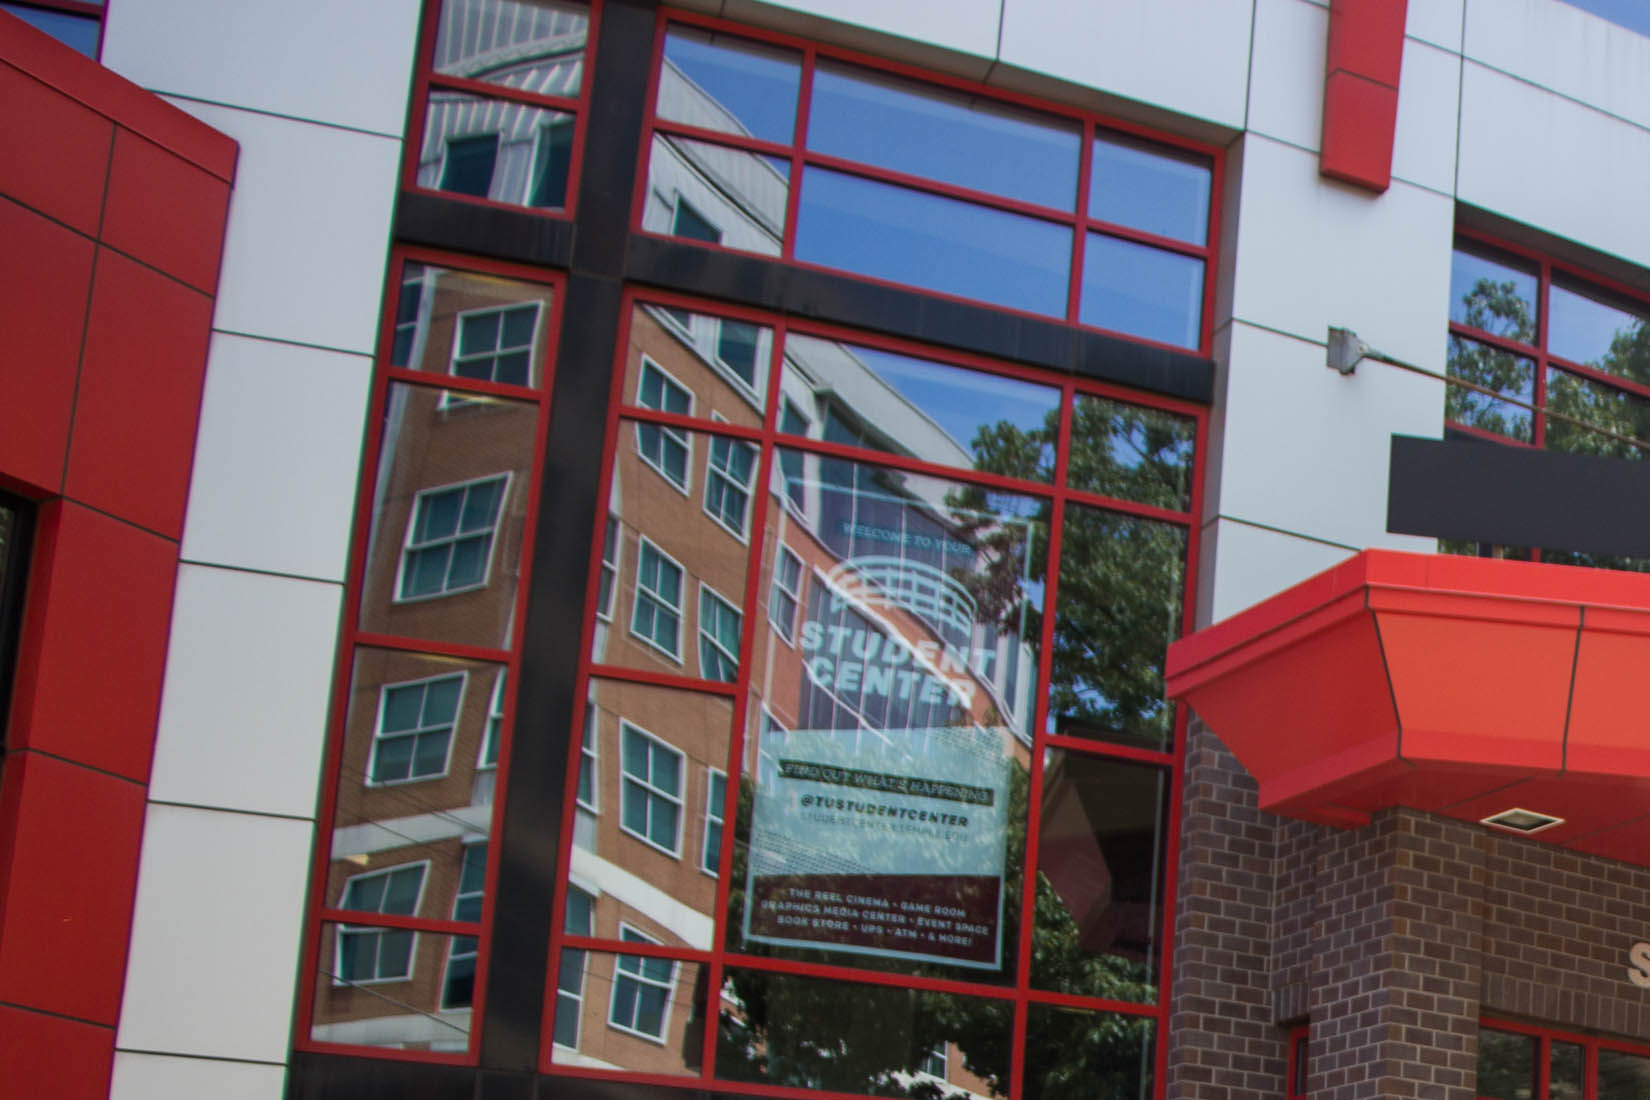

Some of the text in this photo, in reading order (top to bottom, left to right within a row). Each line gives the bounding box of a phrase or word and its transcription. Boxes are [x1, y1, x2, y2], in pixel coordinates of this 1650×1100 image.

[843, 522, 972, 554] WELCOME TO YOUR
[801, 621, 996, 674] STUDENT
[810, 655, 976, 709] CENTER
[801, 794, 969, 827] @TUSTUDENTCENTER
[761, 899, 989, 936] GRAPHICS MEDIA CENTER EVENT SPACE
[789, 888, 966, 918] THE REEL CINEMA GAME ROOM
[777, 915, 808, 926] BOOK
[812, 918, 849, 930] STORE
[861, 922, 883, 935] UPS
[894, 928, 917, 940] ATM
